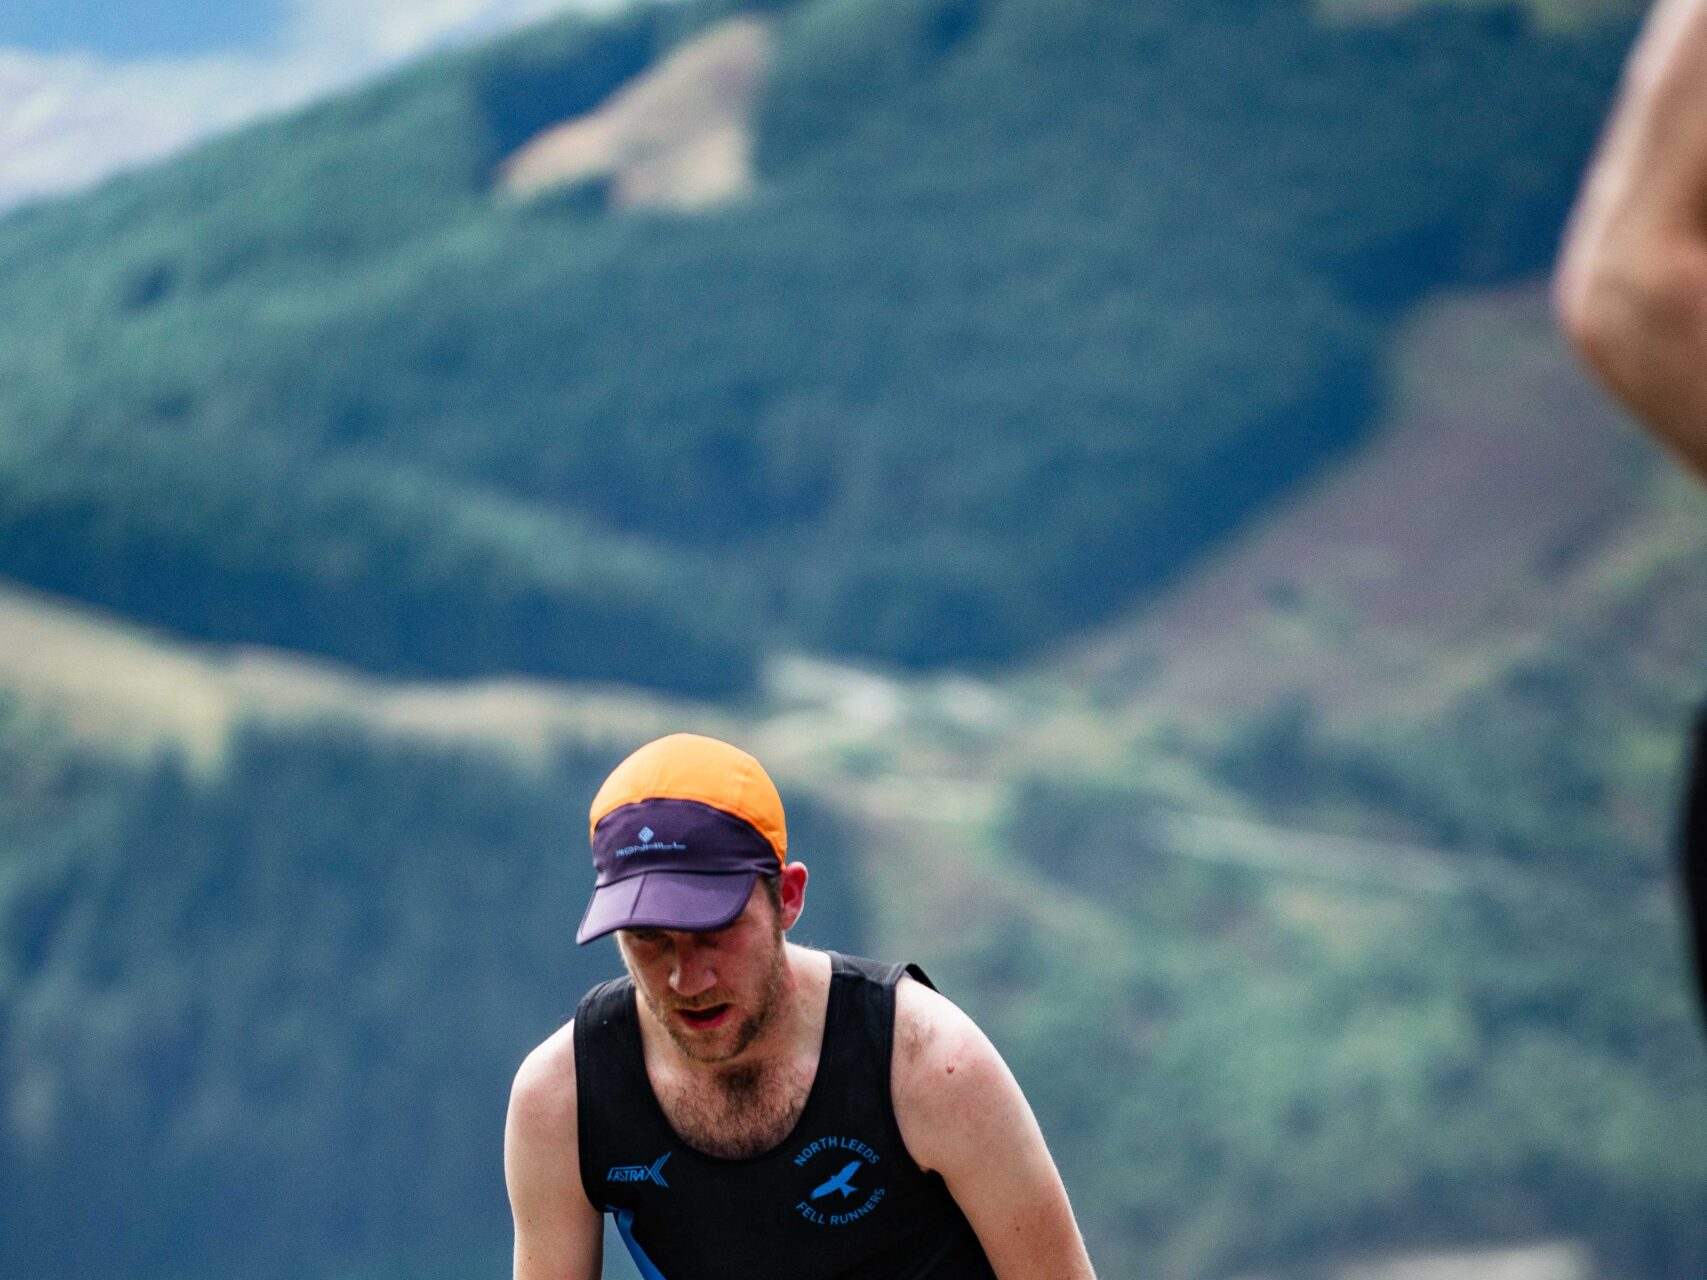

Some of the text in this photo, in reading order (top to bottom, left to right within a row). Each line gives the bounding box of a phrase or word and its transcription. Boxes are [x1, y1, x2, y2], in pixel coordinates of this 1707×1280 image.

[794, 1136, 880, 1167] NORTH LEEDS
[796, 1188, 885, 1226] FELL RUNNERS
